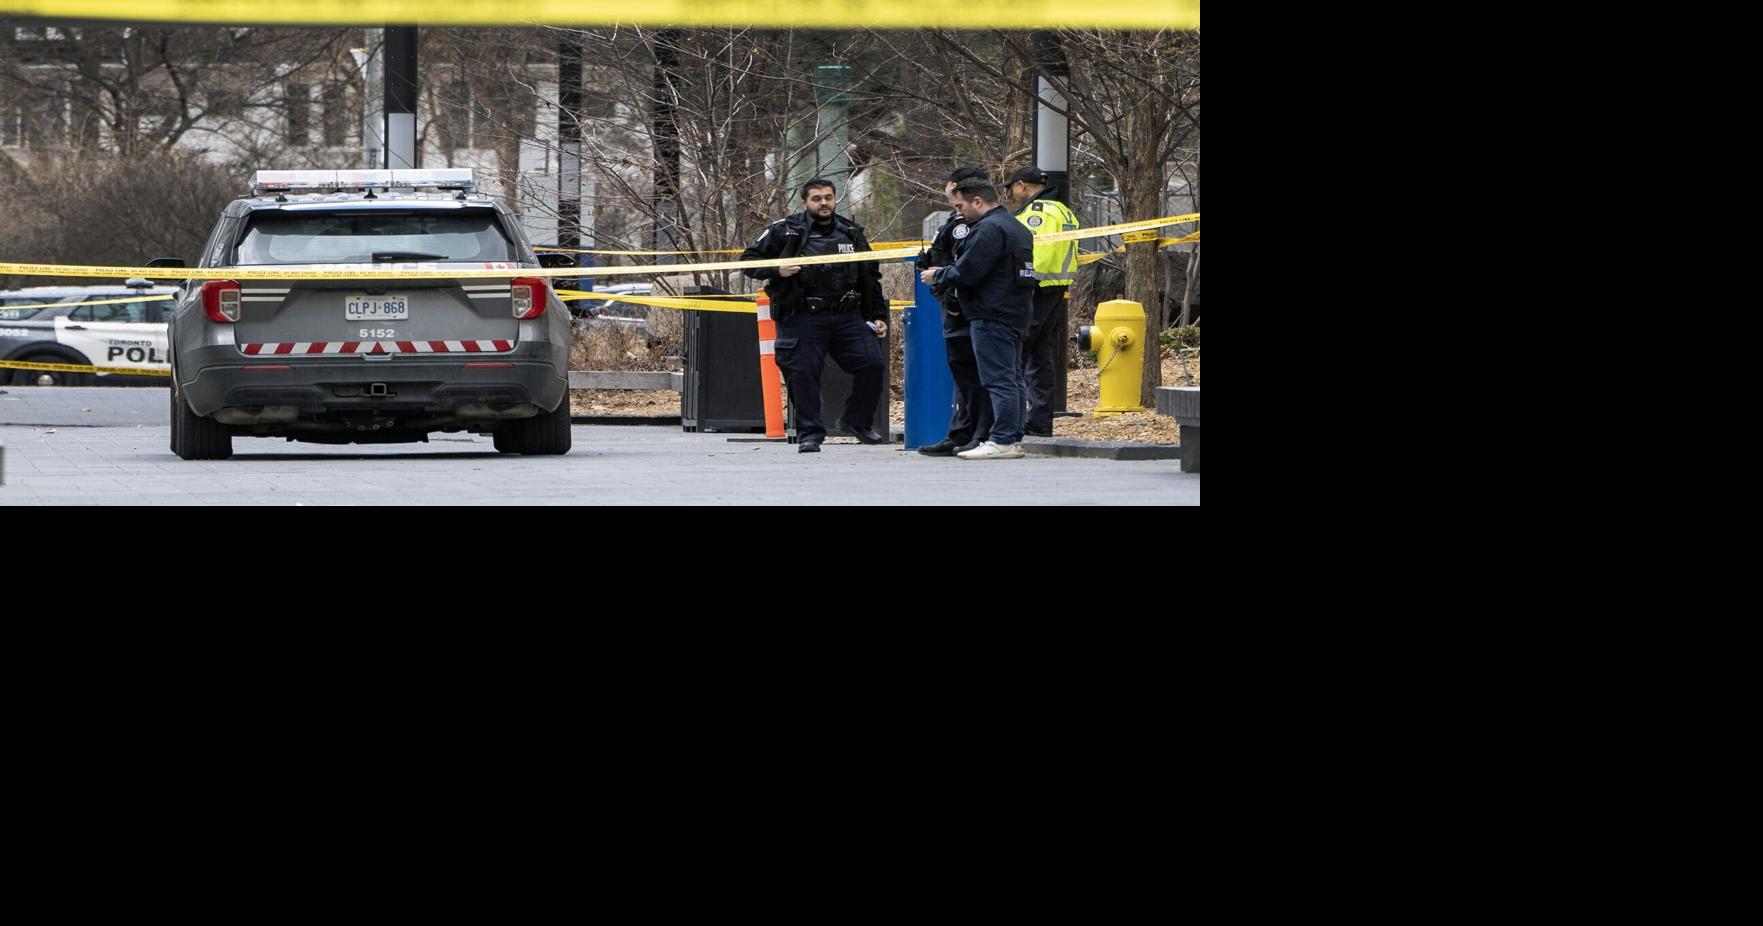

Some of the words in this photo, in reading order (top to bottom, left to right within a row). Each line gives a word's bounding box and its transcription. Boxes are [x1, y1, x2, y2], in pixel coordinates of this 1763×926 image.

[838, 243, 855, 253] POLICE
[348, 302, 377, 314] CLPJ
[383, 301, 405, 314] 868
[359, 328, 395, 338] 5152
[108, 339, 152, 347] TORONTO
